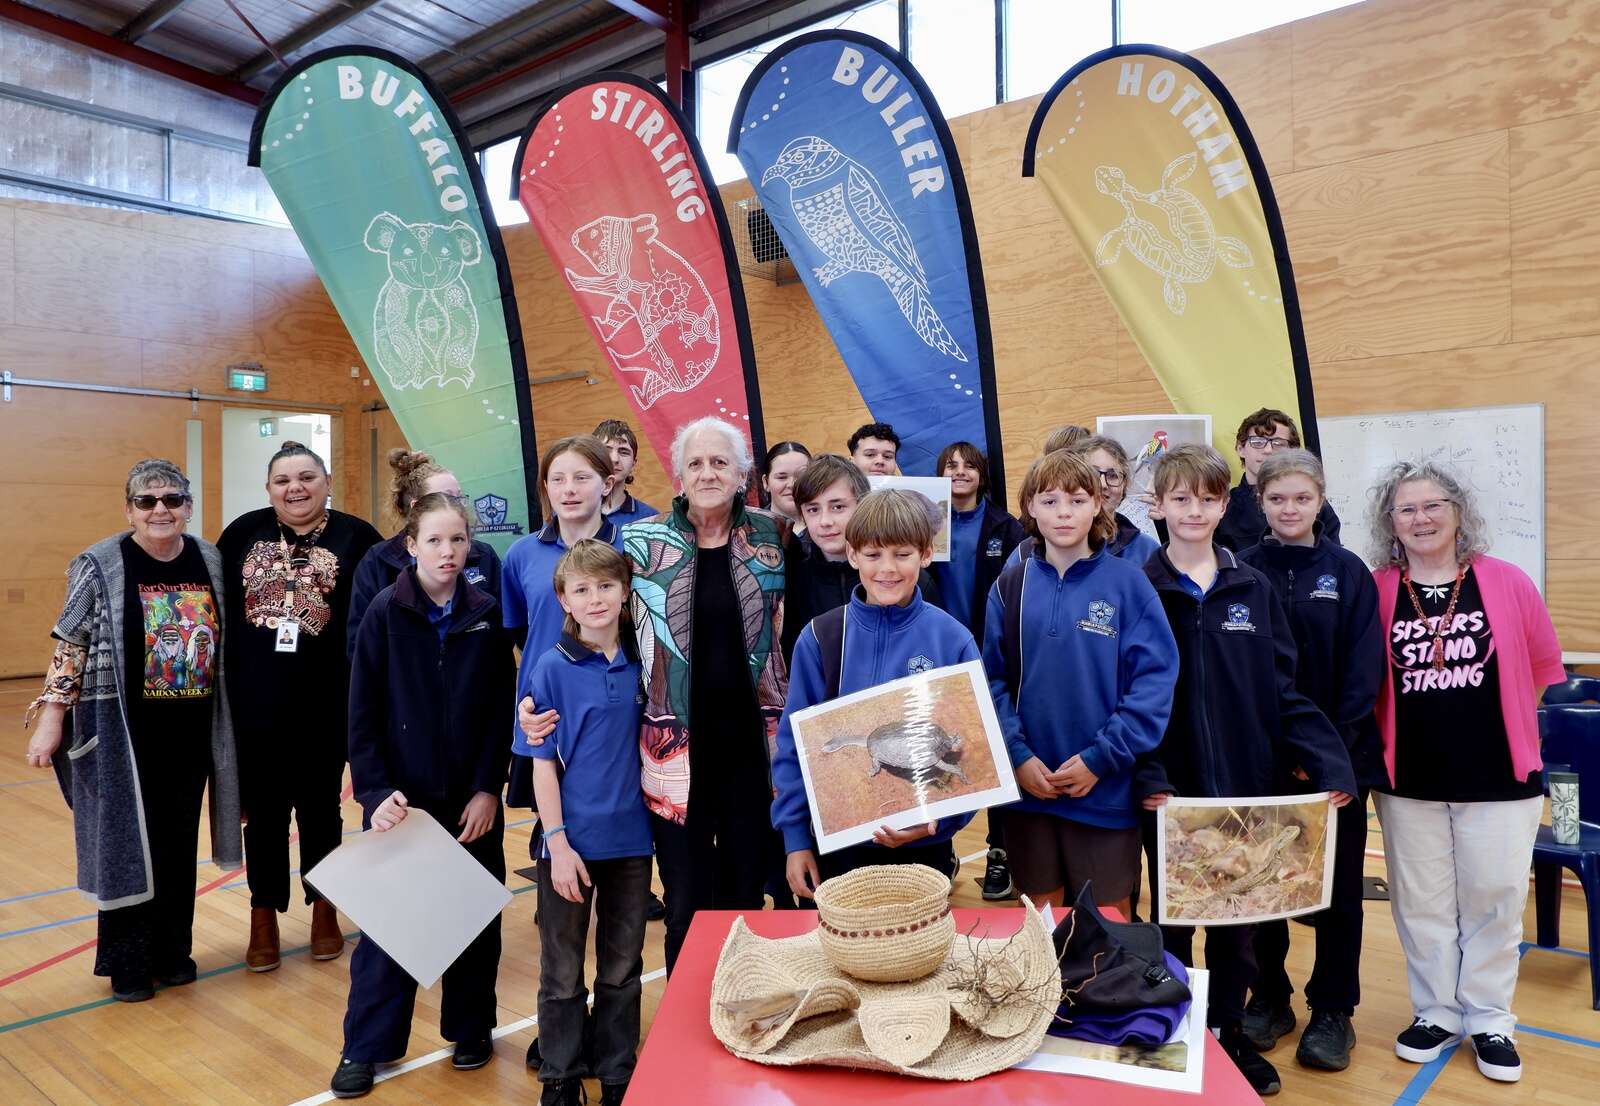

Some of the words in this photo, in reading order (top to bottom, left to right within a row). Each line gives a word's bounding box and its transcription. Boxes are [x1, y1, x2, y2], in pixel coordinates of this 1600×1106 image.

[338, 65, 468, 212] BUFFALO
[591, 87, 706, 222] STIRLING
[832, 46, 945, 199] BULLER
[1117, 63, 1249, 200] HOTHAM
[138, 583, 156, 592] For
[157, 582, 179, 592] Our
[143, 689, 179, 697] NAIDOC
[180, 688, 202, 696] WEEK
[1402, 662, 1484, 694] STRONG
